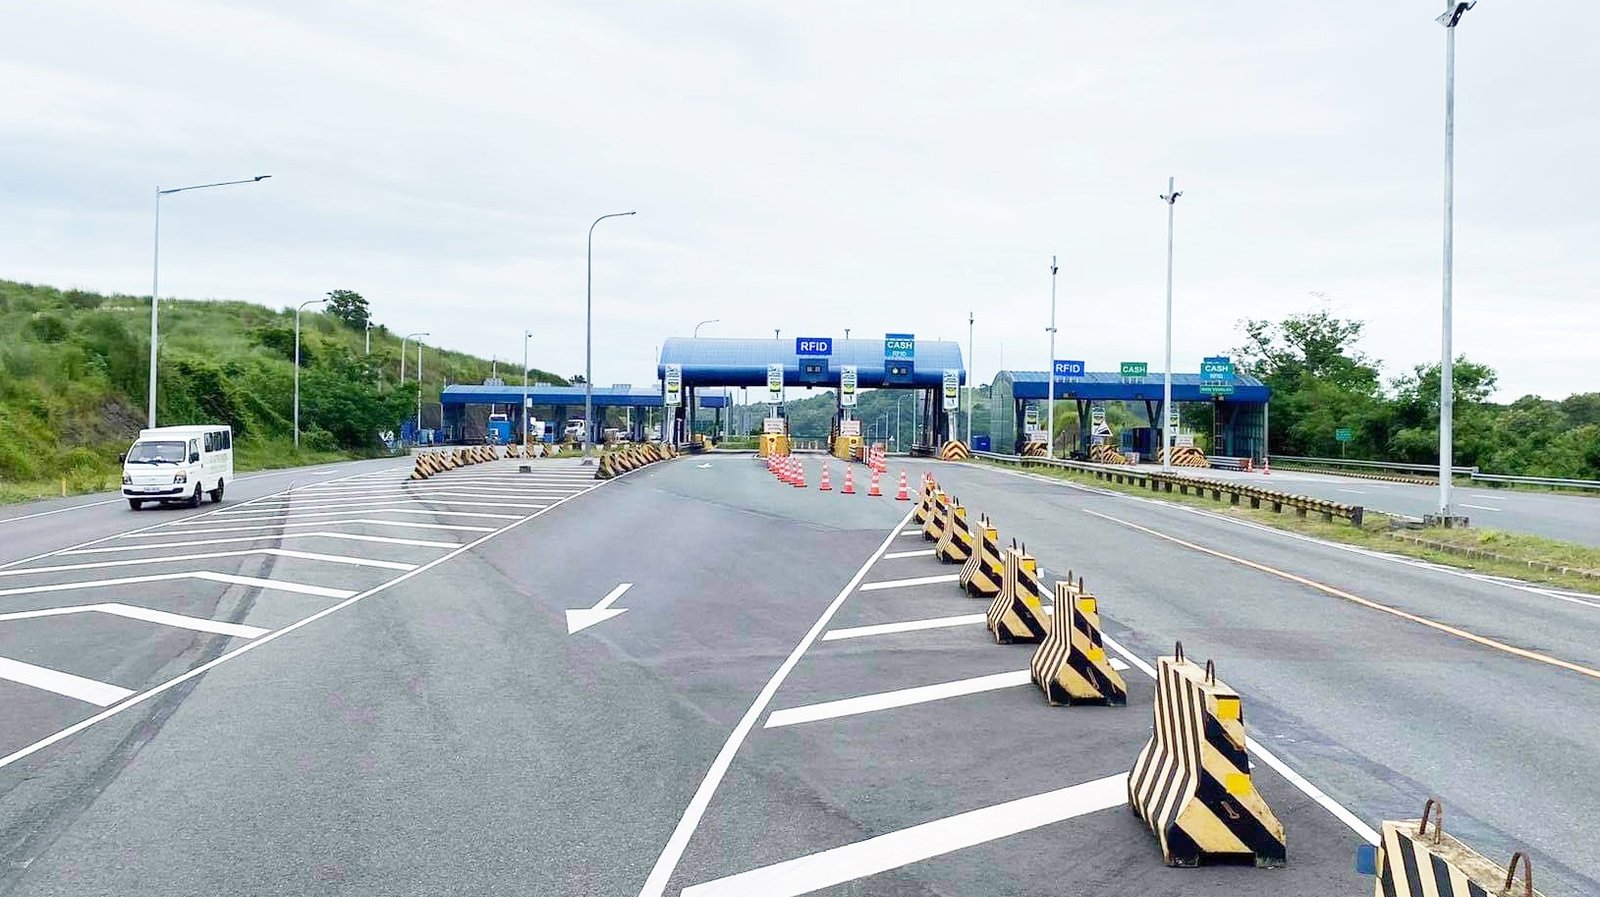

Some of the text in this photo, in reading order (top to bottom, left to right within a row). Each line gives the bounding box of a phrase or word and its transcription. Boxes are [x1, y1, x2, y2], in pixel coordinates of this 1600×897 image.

[801, 342, 828, 351] RFID
[887, 341, 912, 349] CASH
[1055, 363, 1080, 373] RFID
[1122, 366, 1146, 374] CASH
